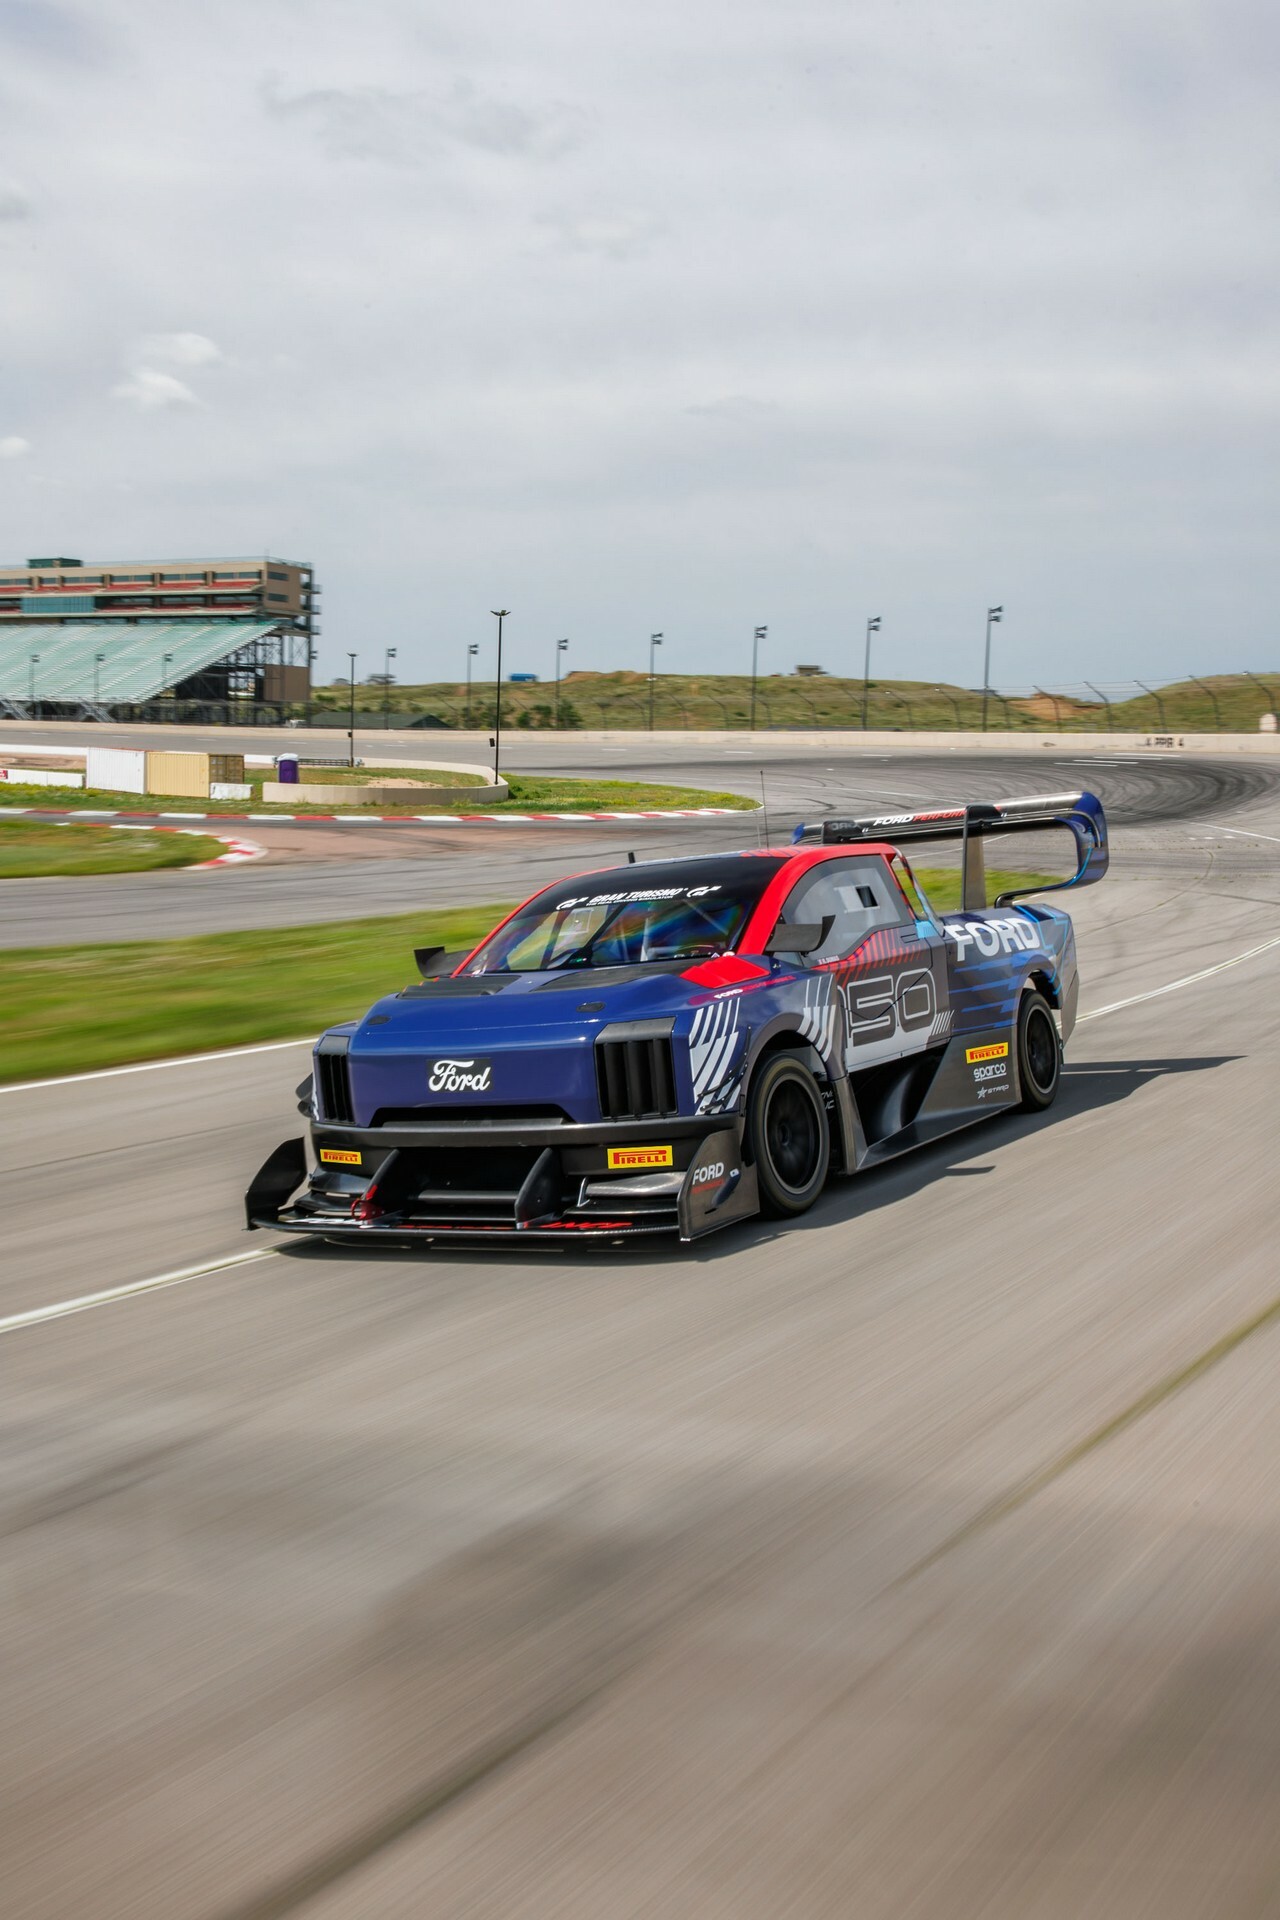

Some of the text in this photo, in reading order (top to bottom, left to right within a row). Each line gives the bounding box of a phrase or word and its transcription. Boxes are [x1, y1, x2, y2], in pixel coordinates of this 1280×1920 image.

[873, 815, 914, 826] FORD
[943, 917, 1040, 962] FORD
[969, 1045, 1005, 1060] PIRELLI
[428, 1059, 491, 1092] Ford
[973, 1062, 1007, 1082] sparco
[323, 1151, 358, 1162] PIRELLI
[613, 1149, 667, 1165] PIRELLI
[692, 1162, 725, 1186] FORD
